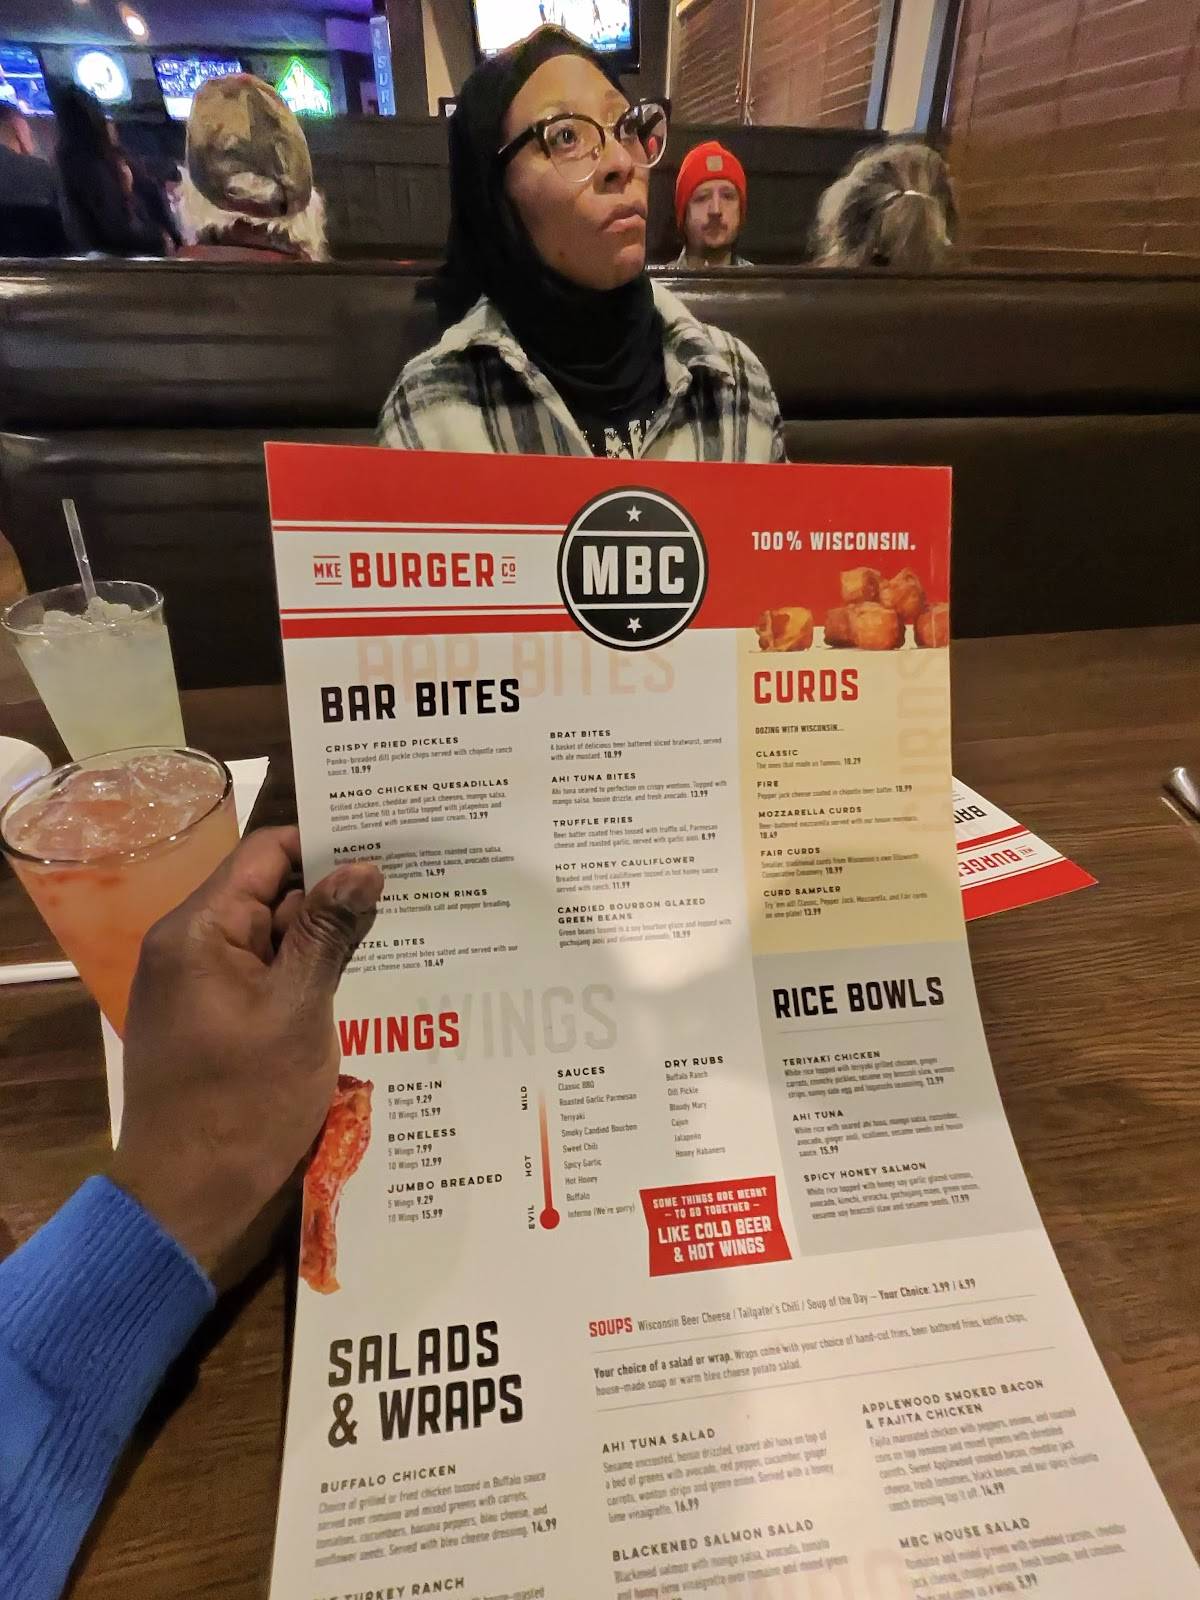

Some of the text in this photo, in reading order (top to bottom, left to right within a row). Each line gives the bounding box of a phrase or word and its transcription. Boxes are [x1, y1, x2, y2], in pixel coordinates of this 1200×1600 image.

[752, 531, 916, 551] 100% WISCONSIN.
[313, 562, 342, 578] MKE
[350, 552, 494, 588] BURGER
[582, 545, 685, 595] MBC
[754, 668, 859, 704] CURDS
[321, 678, 519, 723] BAR BITES
[550, 730, 611, 739] BRAT BITES
[755, 726, 780, 735] OOZING
[781, 725, 798, 733] WITH
[325, 737, 459, 752] CRISPY FRIED PICKLES
[604, 751, 622, 759] 10.99
[756, 750, 798, 758] CLASSIC
[351, 765, 371, 774] 10.99
[574, 774, 602, 782] TUNA
[330, 778, 509, 799] MANGO CHICKEN QUESADILLAS
[758, 806, 862, 818] MOZZARELLA CURDS
[553, 818, 599, 827] TRUFFLE
[333, 842, 381, 854] NACHOS
[761, 849, 783, 857] FAIR
[555, 856, 695, 871] HOT HONEY CAULIFLOWER
[414, 888, 488, 900] ONION RINGS
[763, 886, 841, 897] CURD SAMPLER
[557, 898, 705, 914] CANDIED BOURBON GLAZED
[558, 913, 633, 924] GREEN BEANS
[360, 938, 425, 949] TZEL BITES
[773, 976, 944, 1019] RICE BOWLS
[416, 984, 618, 1064] WINGS
[338, 1011, 459, 1057] WINGS
[664, 1056, 724, 1068] DRY RUBS
[783, 1051, 880, 1066] TERIYAKI CHICKEN
[557, 1066, 605, 1078] SAUCES
[388, 1080, 442, 1093] BONE-IN
[416, 1094, 432, 1103] 9.29
[420, 1107, 441, 1117] 15.99
[792, 1110, 844, 1122] AHI TUNA
[388, 1128, 456, 1142] BONELESS
[416, 1144, 432, 1153] 7.99
[563, 1143, 598, 1153] Sweet Chili
[421, 1157, 442, 1167] 12.99
[803, 1162, 926, 1182] SPICY HONEY SALMON
[388, 1174, 503, 1194] JUMBO BREADED
[417, 1195, 433, 1204] 9.29
[566, 1192, 590, 1201] Buffalo
[653, 1197, 678, 1209] SOME
[681, 1193, 713, 1206] THINGS
[737, 1187, 768, 1198] MEANT
[422, 1209, 443, 1219] 15.99
[675, 1202, 750, 1219] TO GO TOGETHER
[657, 1215, 772, 1244] LIKE COLD BEER
[673, 1236, 766, 1263] & HOT WINGS
[589, 1317, 633, 1338] SOUPS
[637, 1318, 679, 1331] Wisconsin
[681, 1313, 700, 1326] Beer
[702, 1311, 731, 1323] Cheese
[738, 1304, 781, 1320] Tailgater's
[782, 1300, 800, 1313] Chili
[807, 1299, 827, 1310] Soup
[828, 1296, 837, 1306] of
[838, 1293, 852, 1305] the
[853, 1293, 868, 1305] Day
[878, 1289, 898, 1300] Your
[328, 1320, 499, 1388] SALADS
[593, 1351, 733, 1379] Your choice of a salad or wrap.
[862, 1379, 1044, 1414] APPLEWOOD SMOKED BACON
[328, 1373, 523, 1449] & WRAPS
[865, 1403, 983, 1429] & FAJITA CHICKEN
[602, 1428, 716, 1454] AHI TUNA SALAD
[321, 1464, 457, 1494] BUFFALO CHICKEN
[612, 1519, 814, 1562] BLACKENED SALMON SALAD
[899, 1517, 1030, 1549] MBC HOUSE SALAD
[341, 1586, 405, 1600] TURKEY
[411, 1577, 465, 1596] RANCH
